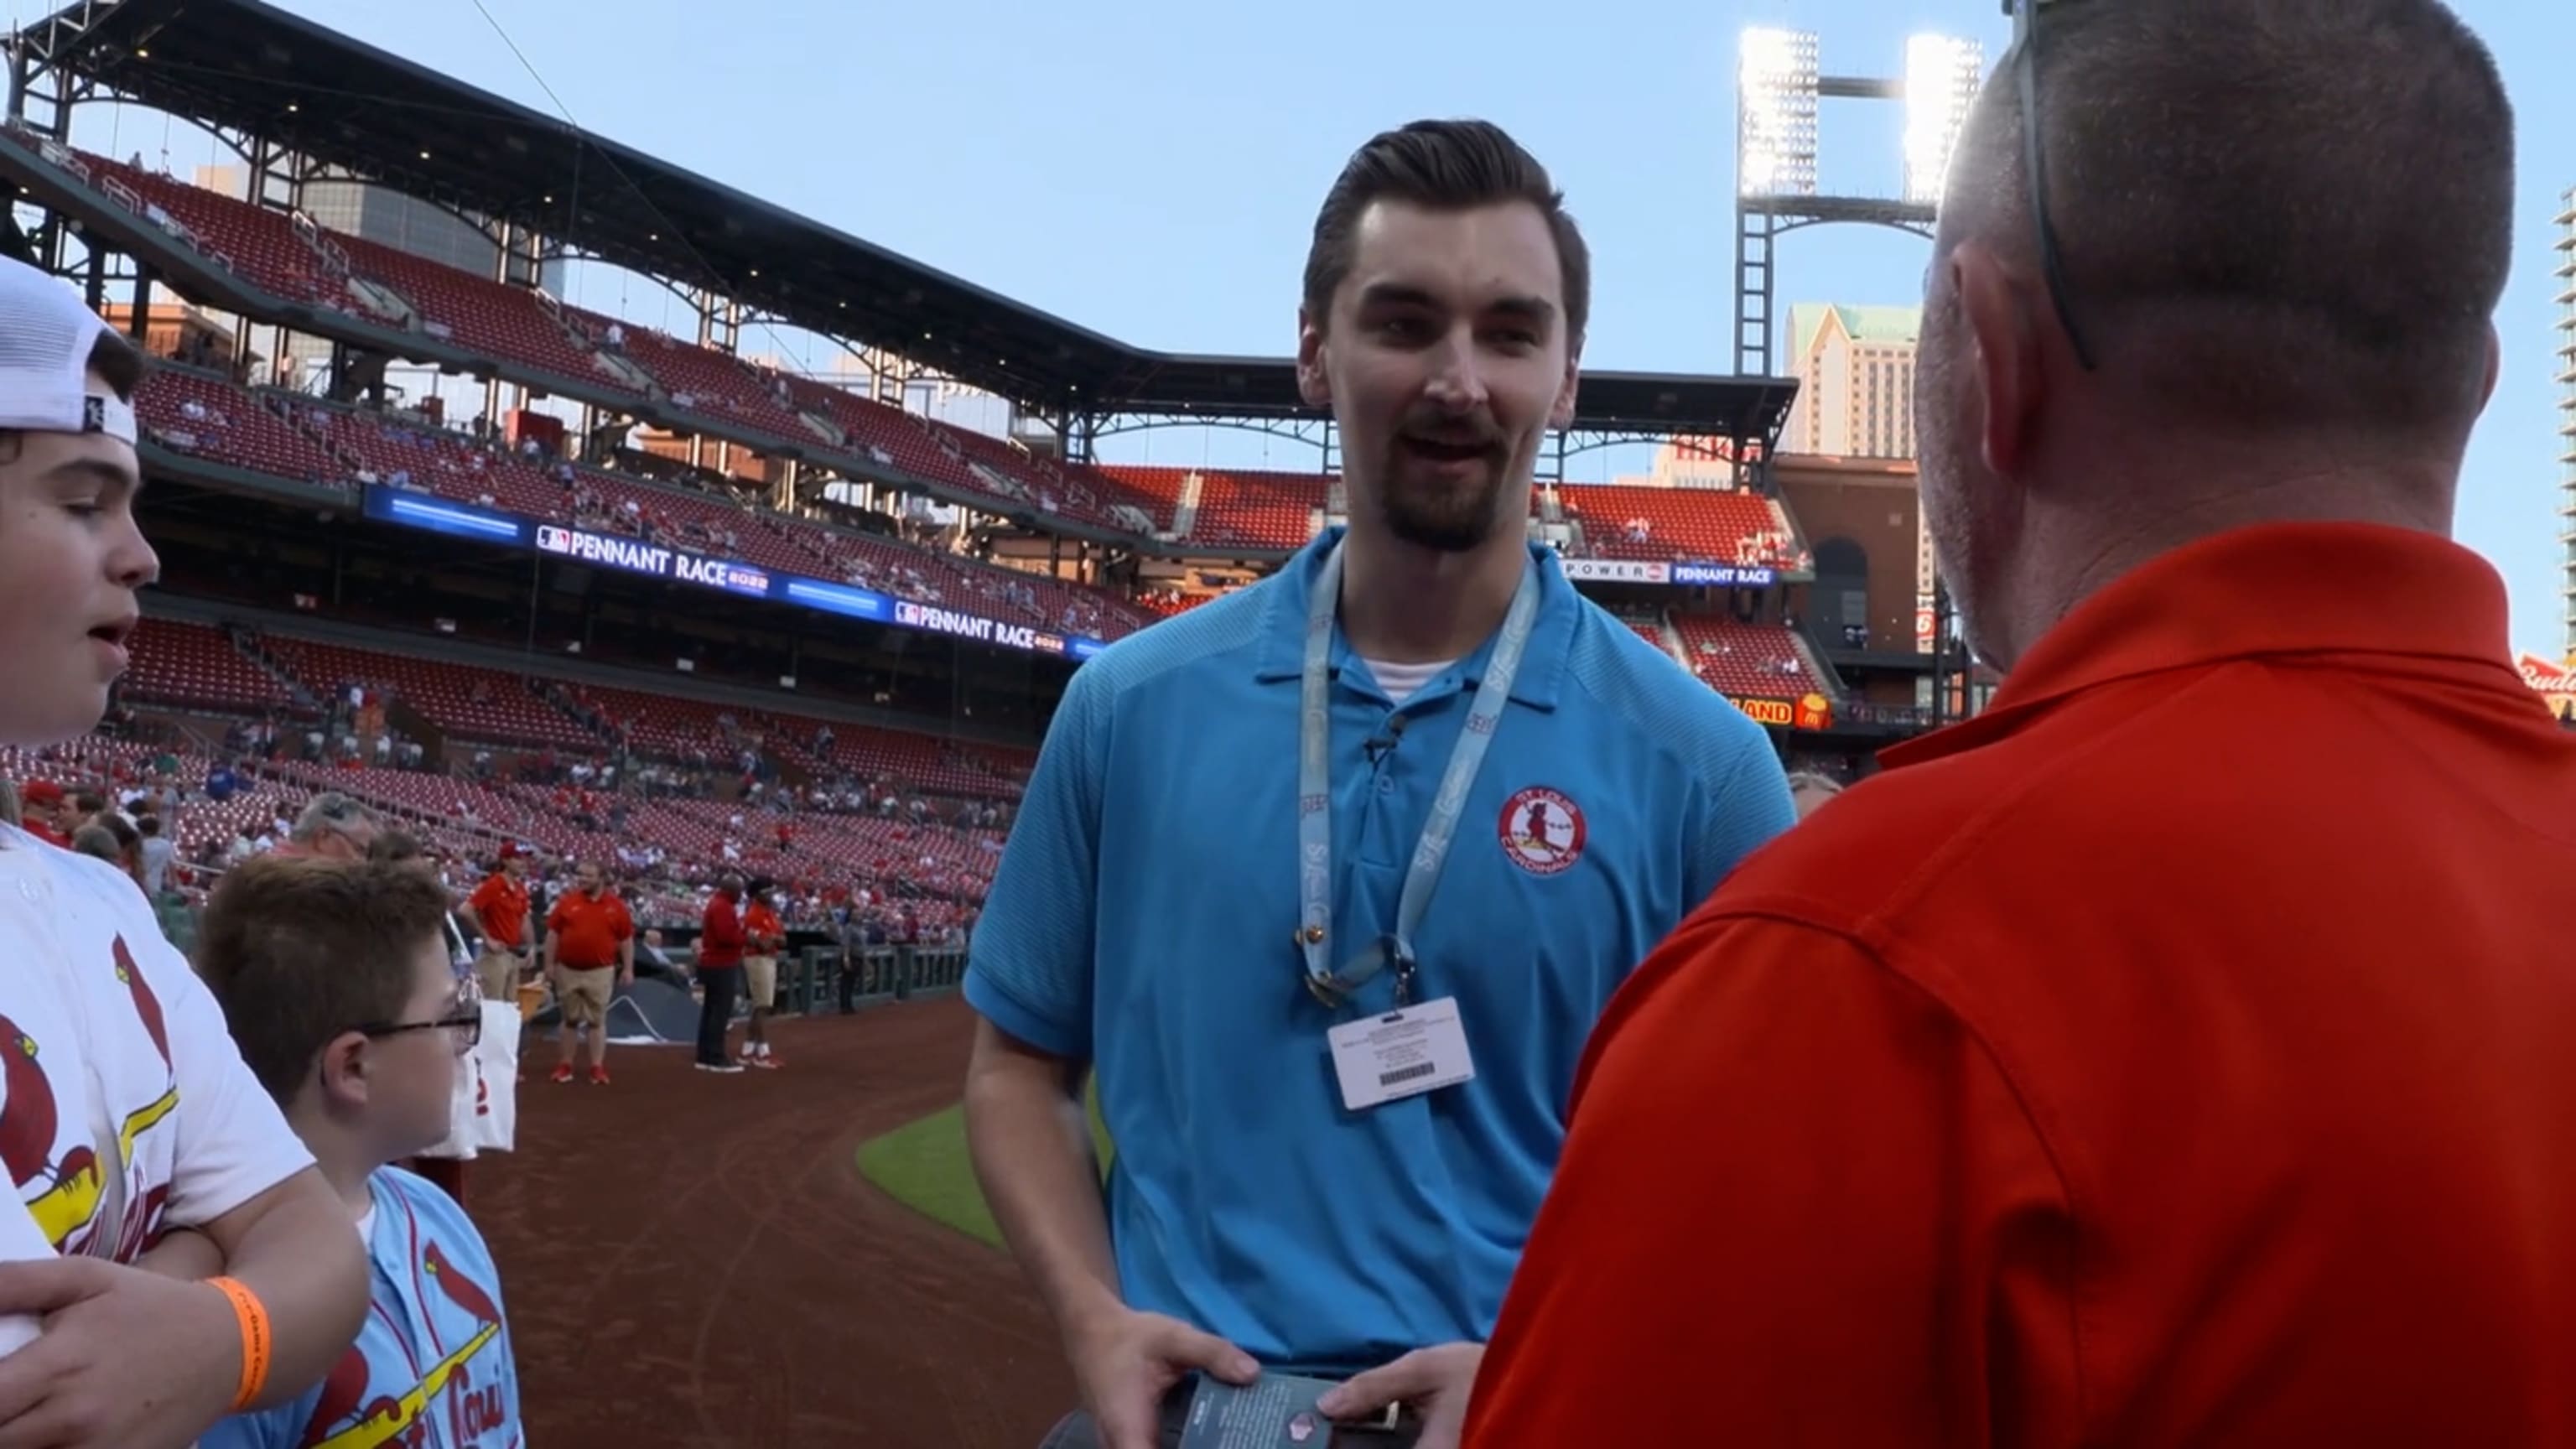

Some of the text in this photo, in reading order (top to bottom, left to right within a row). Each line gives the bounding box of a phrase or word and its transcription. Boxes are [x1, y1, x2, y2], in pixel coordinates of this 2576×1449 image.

[1675, 435, 1761, 461] Hiltn
[570, 532, 670, 574] PENNANT
[676, 554, 727, 586] RACE
[1675, 566, 1771, 584] PENNANT RACE
[920, 607, 992, 640] PENNANT
[995, 623, 1034, 649] RACE
[1501, 836, 1578, 874] CARDINALS
